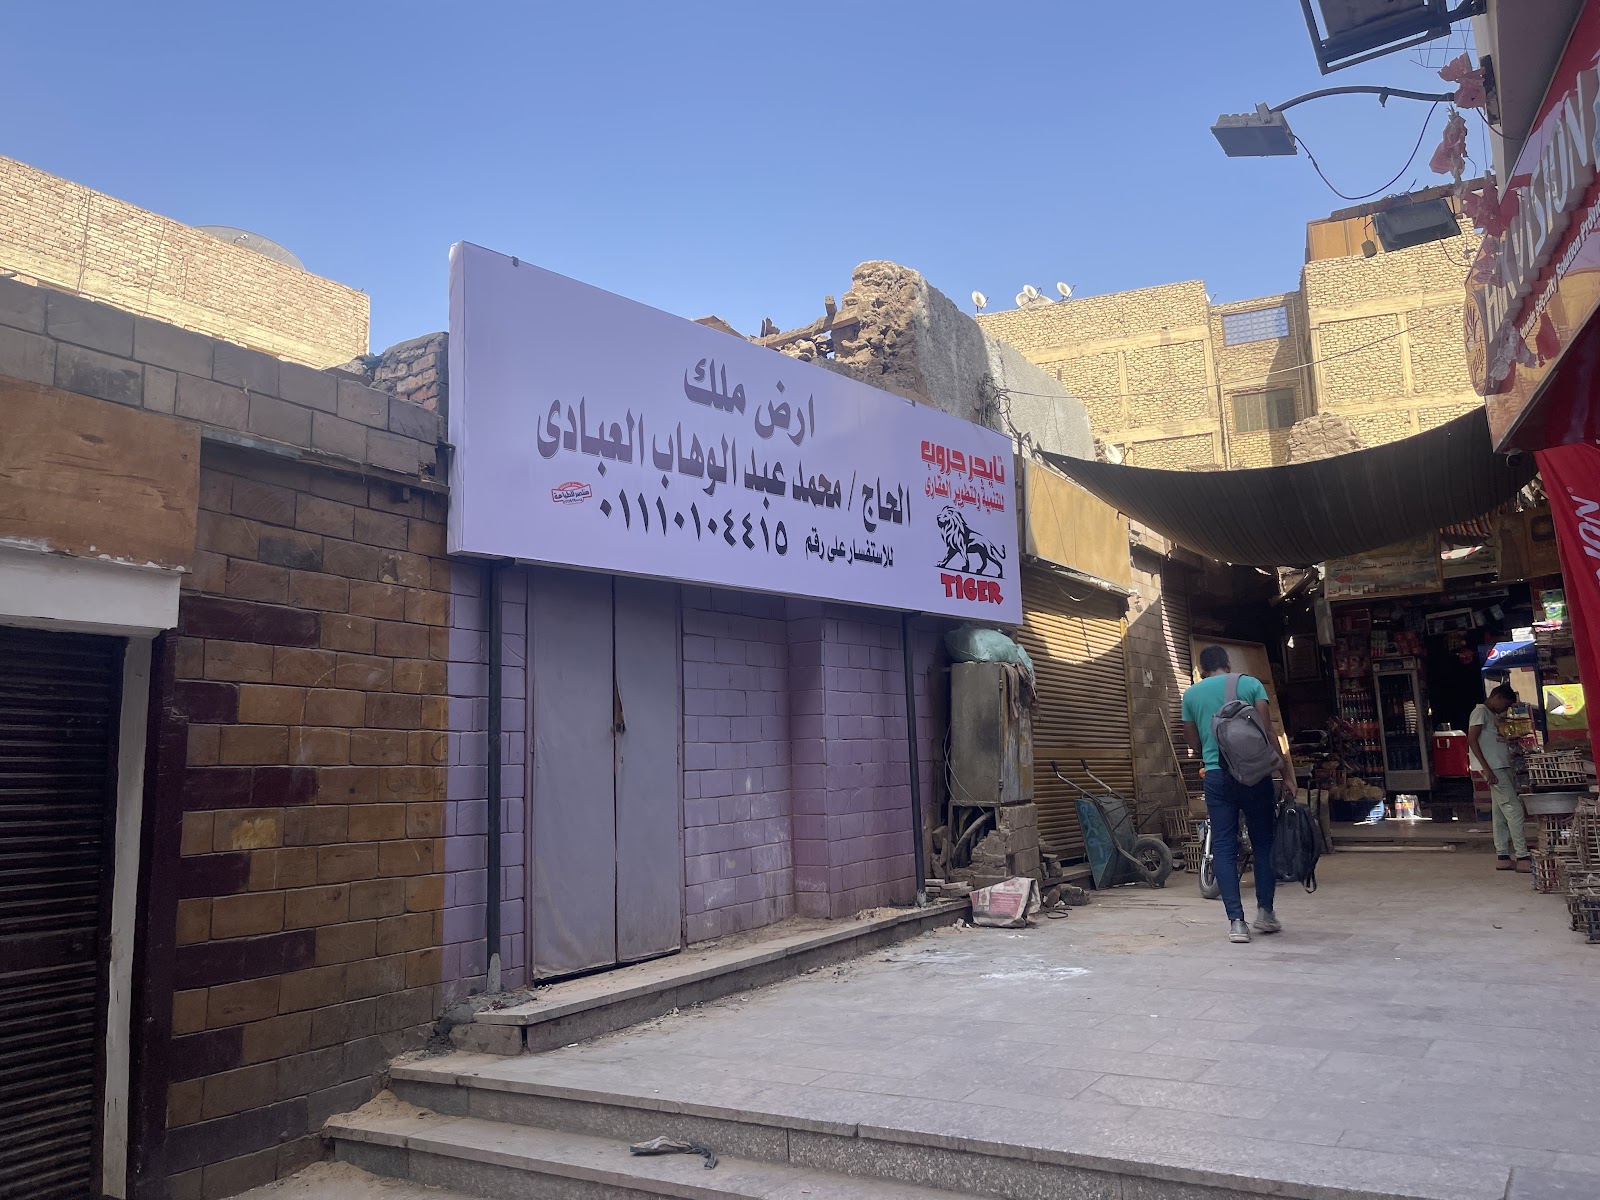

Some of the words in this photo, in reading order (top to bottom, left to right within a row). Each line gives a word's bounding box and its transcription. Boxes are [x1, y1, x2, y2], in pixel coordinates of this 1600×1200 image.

[1535, 274, 1558, 315] Security
[1556, 235, 1581, 280] Solution
[684, 358, 746, 415] ملك
[754, 380, 815, 447] ارض
[652, 421, 737, 497] الوهاب
[744, 447, 786, 510] عبد
[793, 459, 842, 509] محمد
[921, 440, 967, 479] جروب
[968, 455, 1005, 489] تايجر
[600, 488, 788, 556] ٠١١١٠١٠٤٤١٥
[862, 476, 911, 533] الحاج
[982, 486, 1005, 514] للتنمية
[806, 526, 825, 560] رقم
[940, 572, 1003, 605] TIGER
[1500, 648, 1526, 659] pepsi
